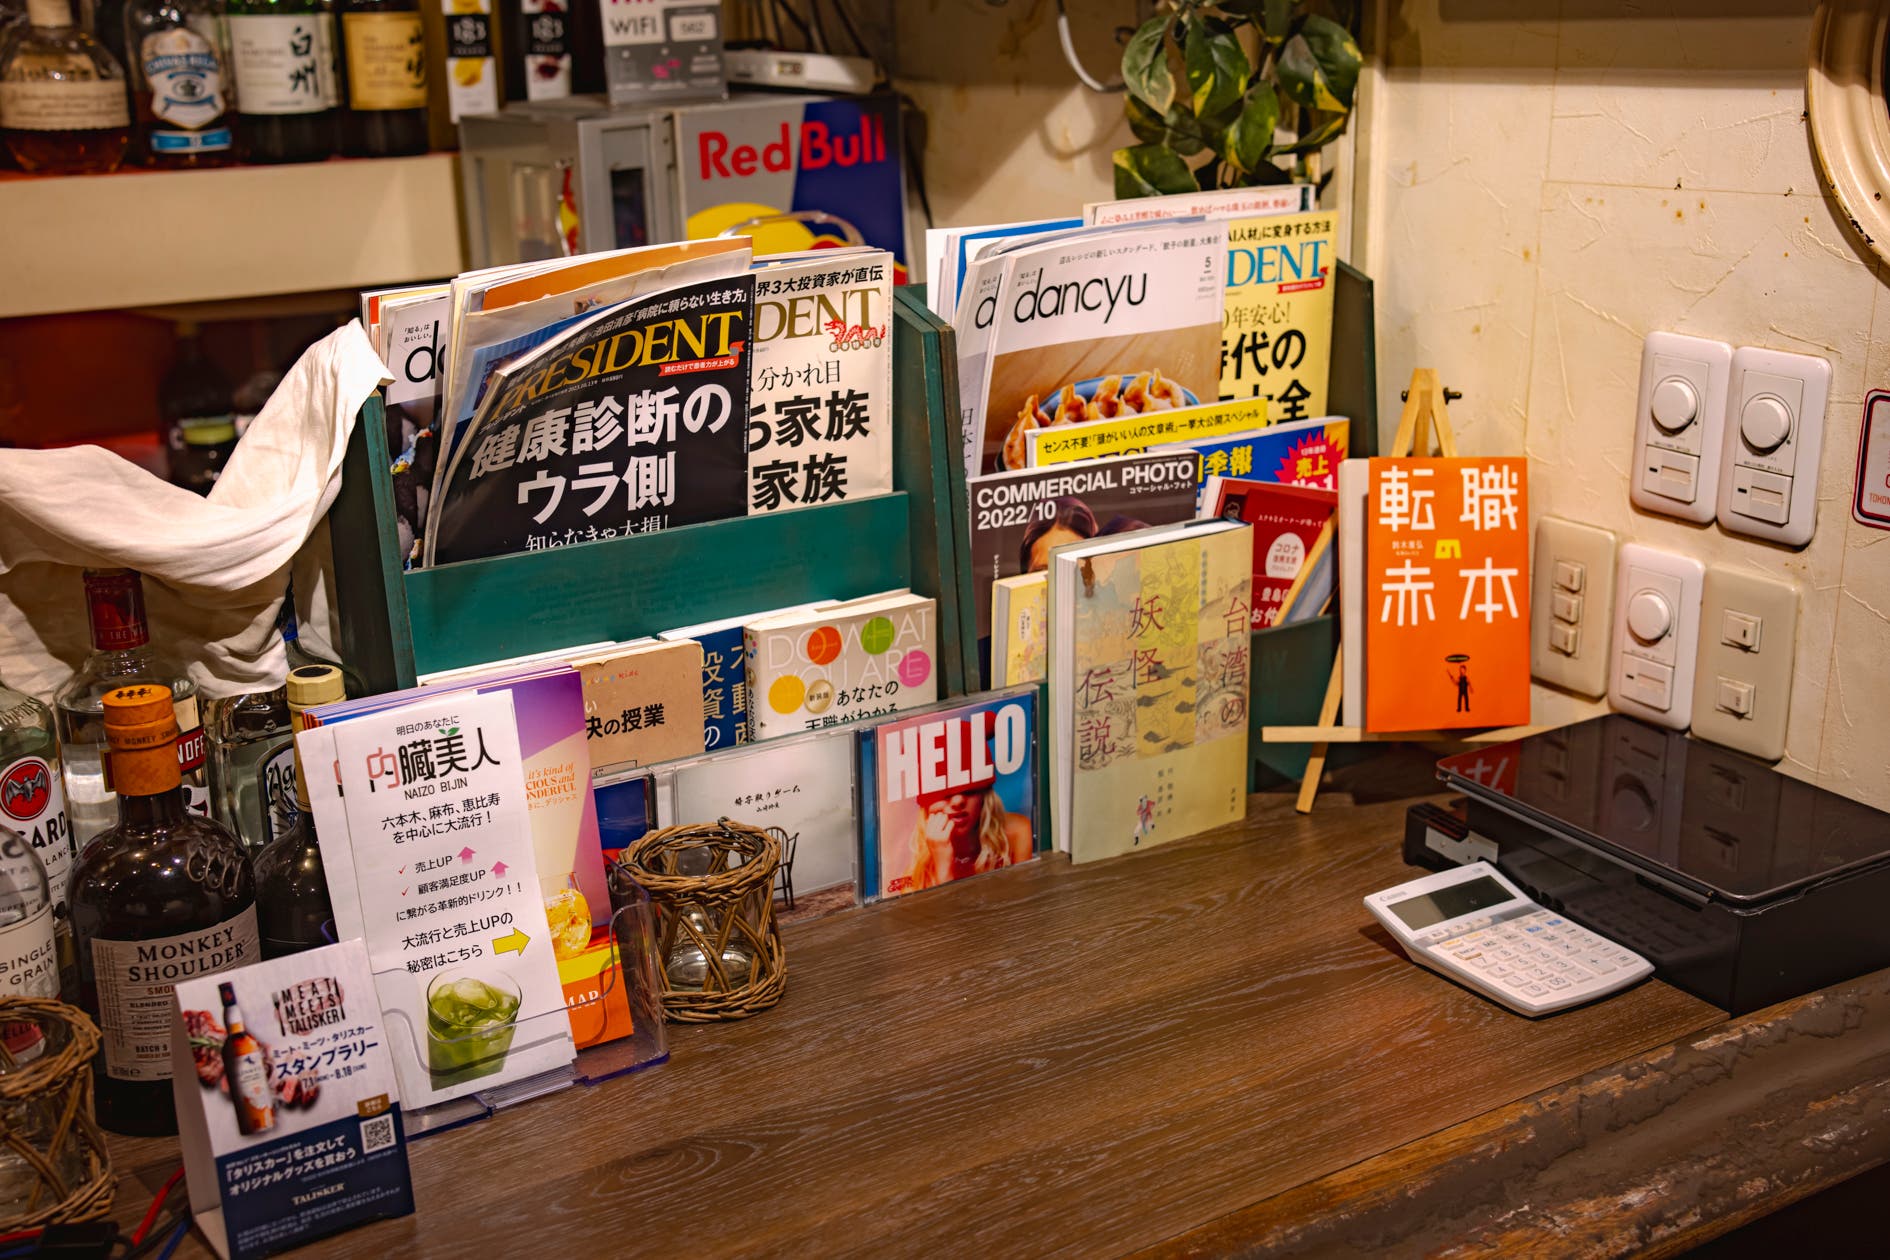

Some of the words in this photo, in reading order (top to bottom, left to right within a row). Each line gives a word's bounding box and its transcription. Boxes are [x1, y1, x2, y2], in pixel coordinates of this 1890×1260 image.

[610, 15, 657, 35] WIFI
[287, 26, 319, 97] 白州
[699, 122, 791, 180] Red
[800, 113, 886, 171] Bull
[1204, 256, 1212, 268] 5
[1226, 240, 1328, 287] DENT
[1014, 267, 1147, 323] dancyu
[753, 287, 882, 343] DENT
[488, 310, 744, 421] PRESIDENT
[469, 383, 732, 480] 健康診断の
[752, 452, 847, 510] 家族
[1198, 445, 1253, 482] 季報
[1295, 455, 1329, 479] 売上
[518, 451, 675, 524] ウラ側
[977, 470, 1117, 508] COMMERCIAL
[1122, 461, 1194, 486] PHOTO
[1379, 465, 1518, 532] 転職
[977, 500, 1057, 530] 2022/10
[1434, 539, 1461, 559] の
[1381, 557, 1519, 627] 赤本
[1127, 595, 1165, 689] 妖怪
[1220, 597, 1249, 727] 台湾の
[836, 680, 900, 706] あなたの
[396, 715, 460, 736] 明日のあなたに
[1077, 667, 1116, 763] 伝説
[366, 727, 500, 793] 内臓美人
[543, 764, 563, 777] kind
[885, 704, 1026, 804] HELLO
[404, 784, 435, 800] NAIZO
[441, 777, 468, 793] BIJIN
[382, 793, 501, 830] 六本木、麻布、恵比寿
[393, 811, 492, 844] を中心に大流行！
[415, 855, 453, 873] 売上UP
[418, 869, 486, 896] 顧客満足度UP
[138, 927, 233, 963] MONKEY
[402, 912, 513, 950] 大流行と売上UPの
[10, 955, 54, 986] GRAIN
[129, 943, 243, 983] SHOULDER
[407, 944, 483, 974] 秘密はこちら
[281, 978, 331, 1004] MEAT
[285, 994, 336, 1020] MEETS
[289, 1009, 340, 1035] TALISKER
